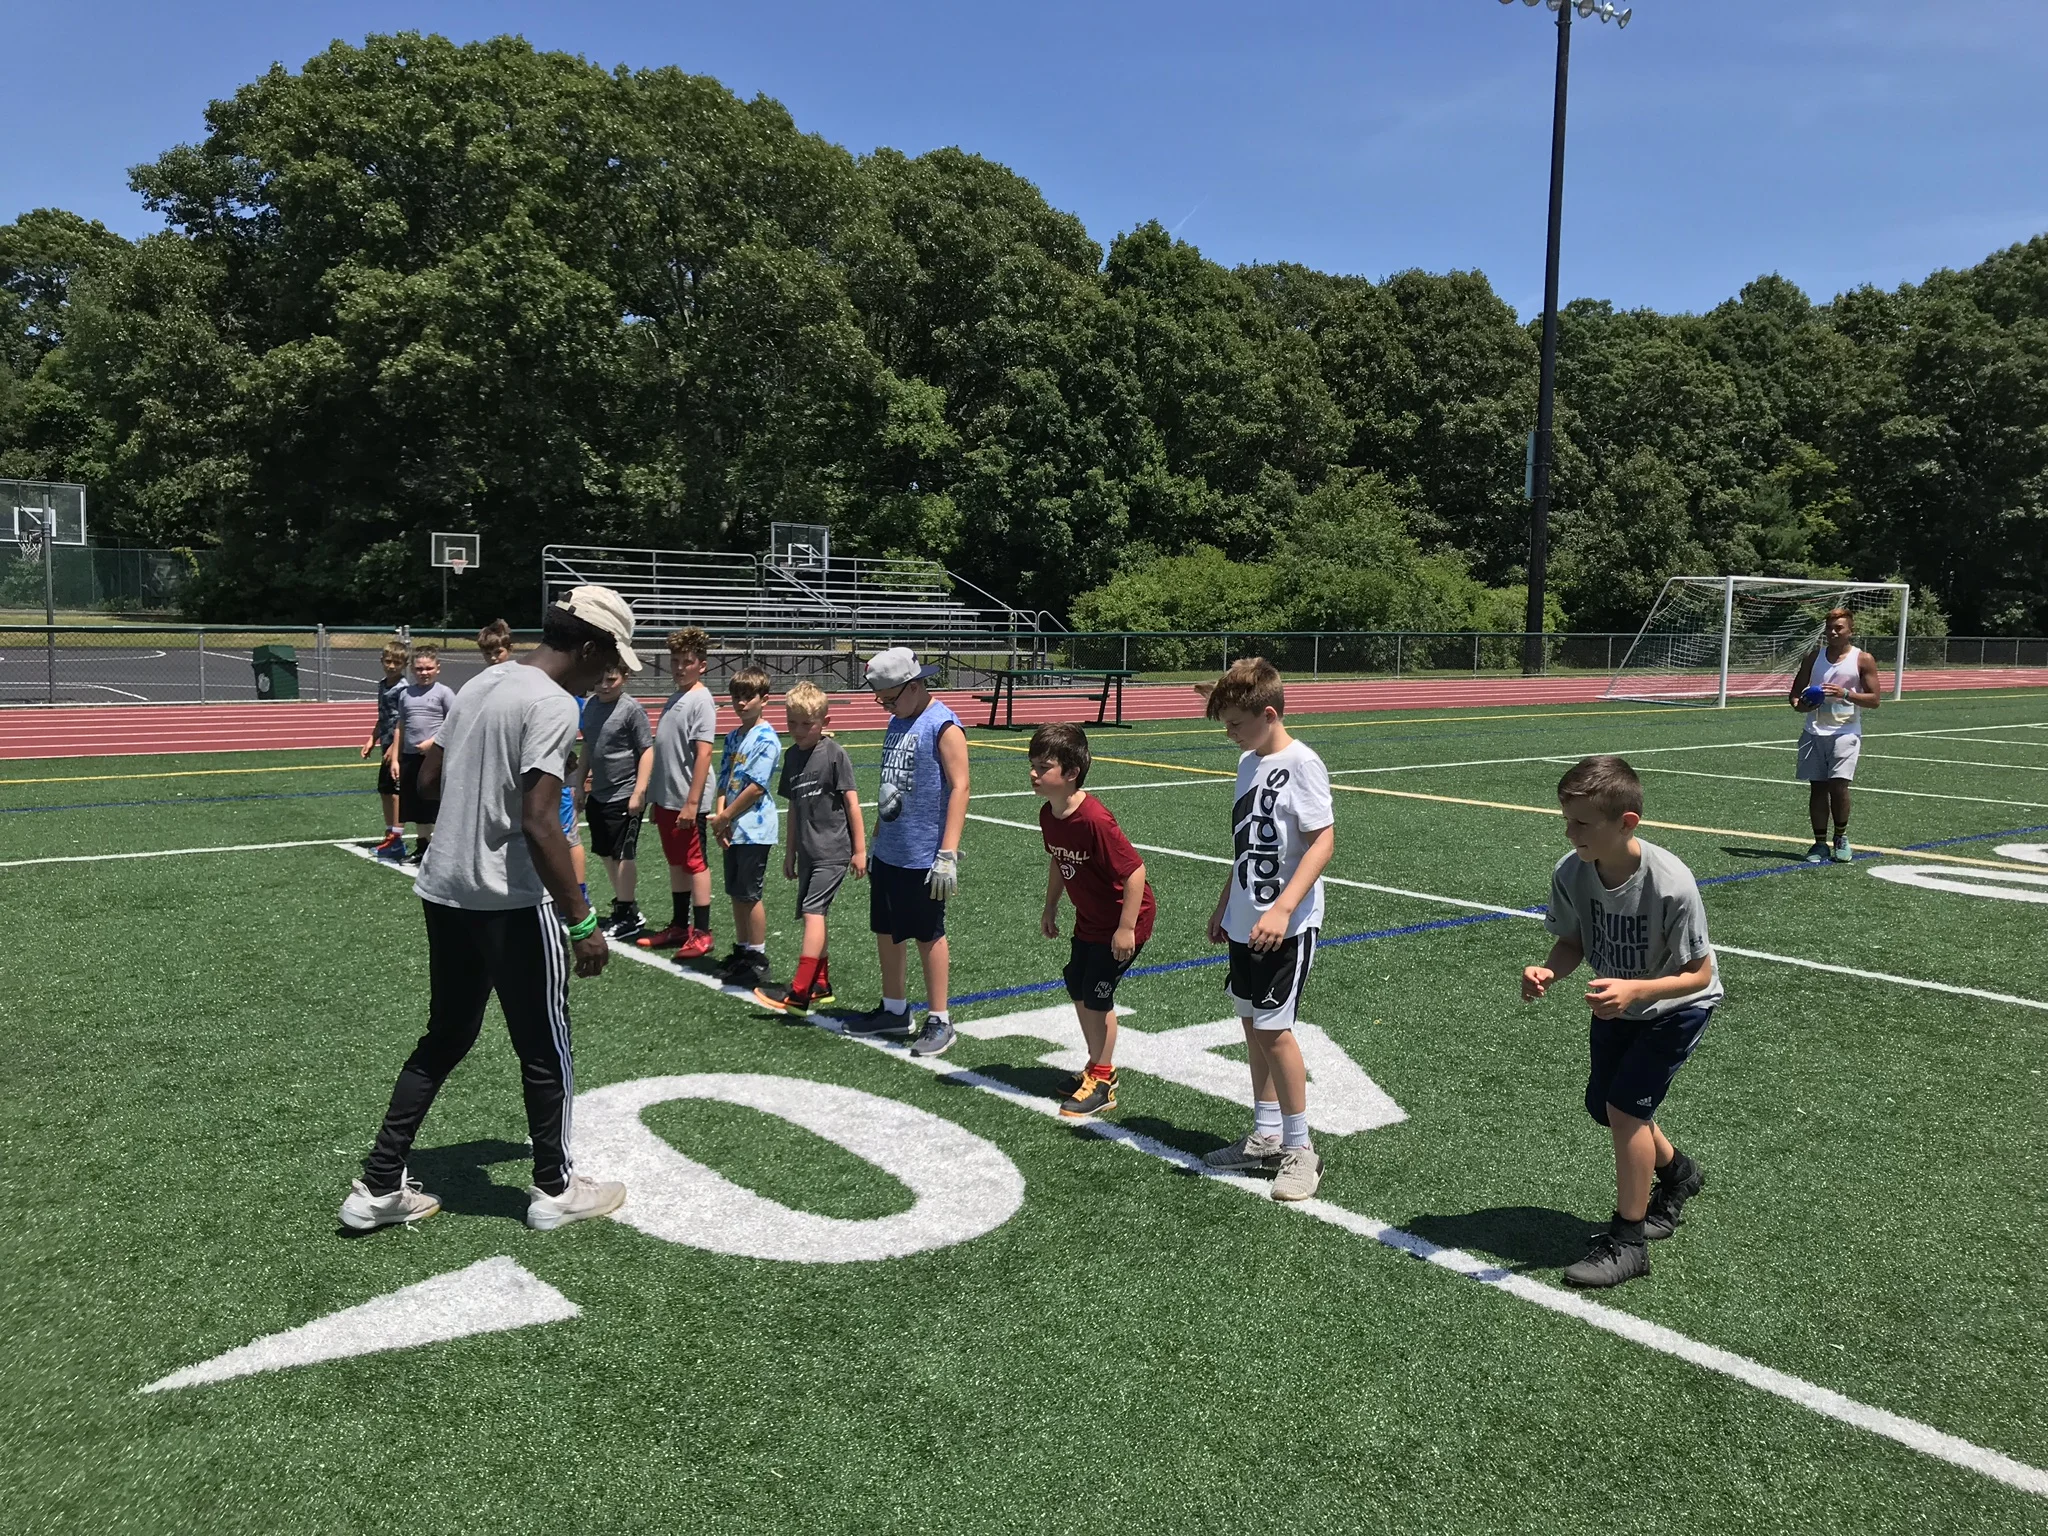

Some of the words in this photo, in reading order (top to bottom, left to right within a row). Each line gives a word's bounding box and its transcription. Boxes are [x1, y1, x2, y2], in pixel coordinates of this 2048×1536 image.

[1047, 843, 1090, 860] OTBALL
[1252, 768, 1290, 904] adidas
[1590, 898, 1648, 944] PURE
[1592, 924, 1649, 970] PARIOT
